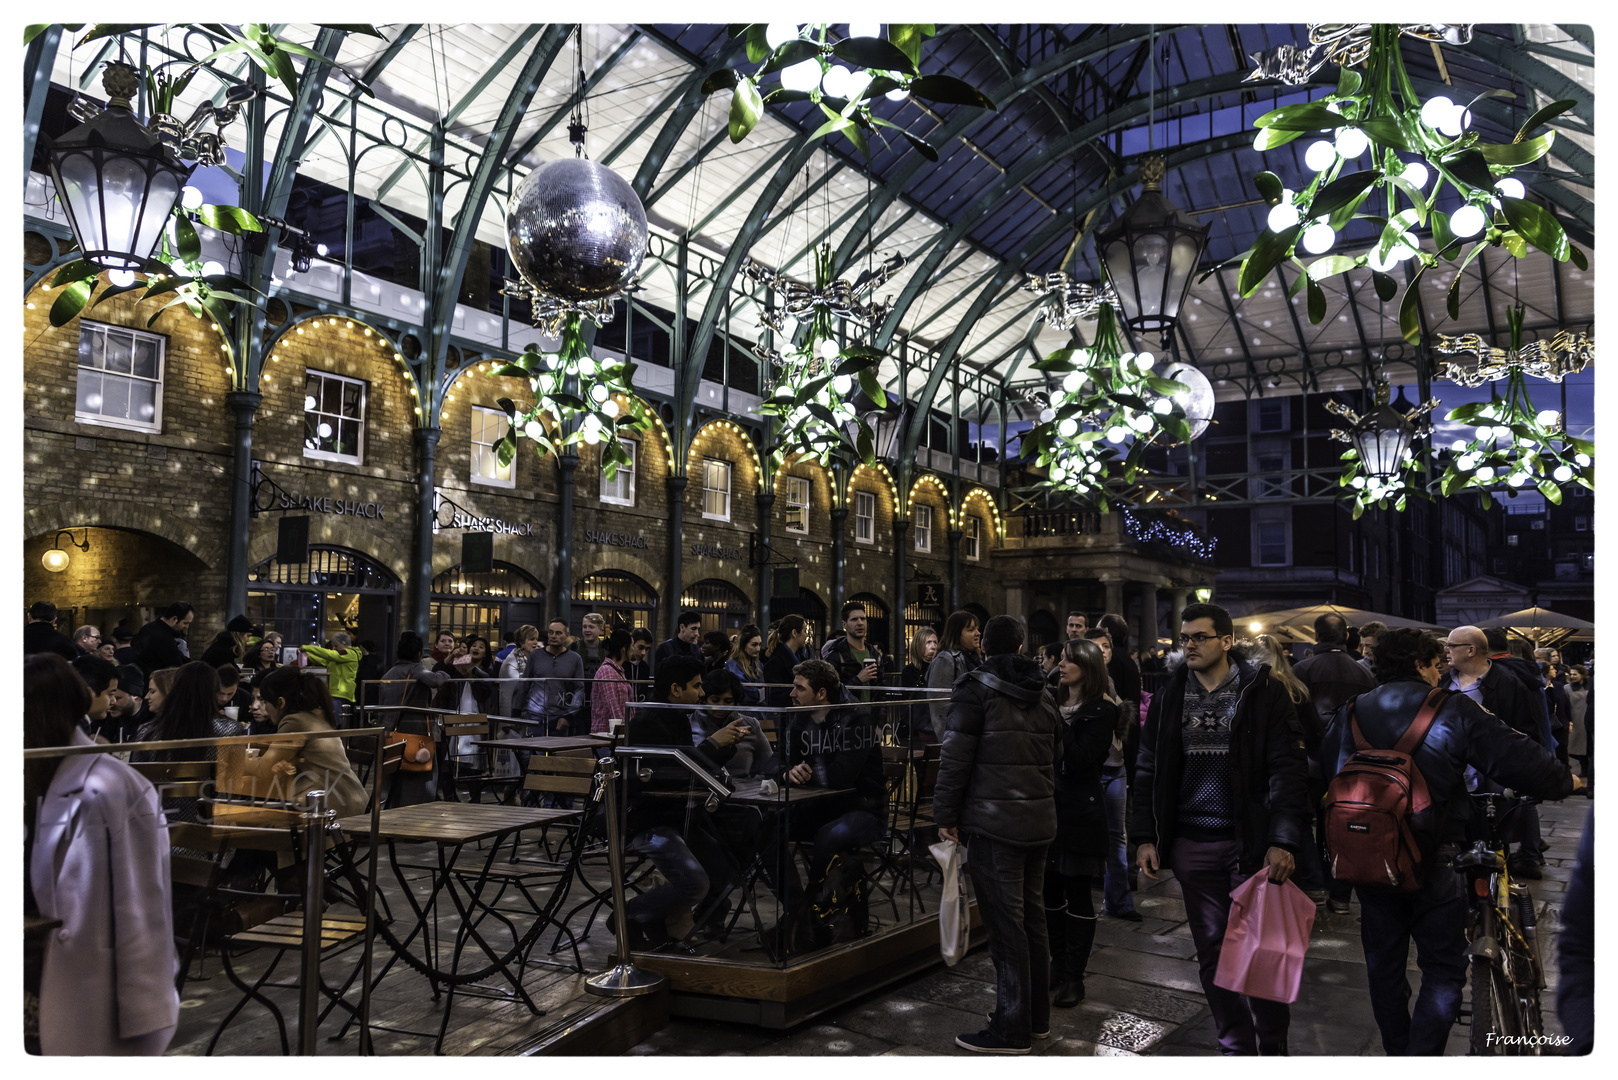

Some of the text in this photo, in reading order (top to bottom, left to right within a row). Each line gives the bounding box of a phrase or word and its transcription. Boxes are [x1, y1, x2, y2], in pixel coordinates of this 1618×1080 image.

[280, 492, 385, 520] SHAKE SHACK
[453, 514, 535, 537] SHAKE SHACK
[585, 529, 650, 549] SHAKE SHACK
[692, 543, 717, 558] SHAKE
[800, 722, 901, 756] SHAKE SHACK
